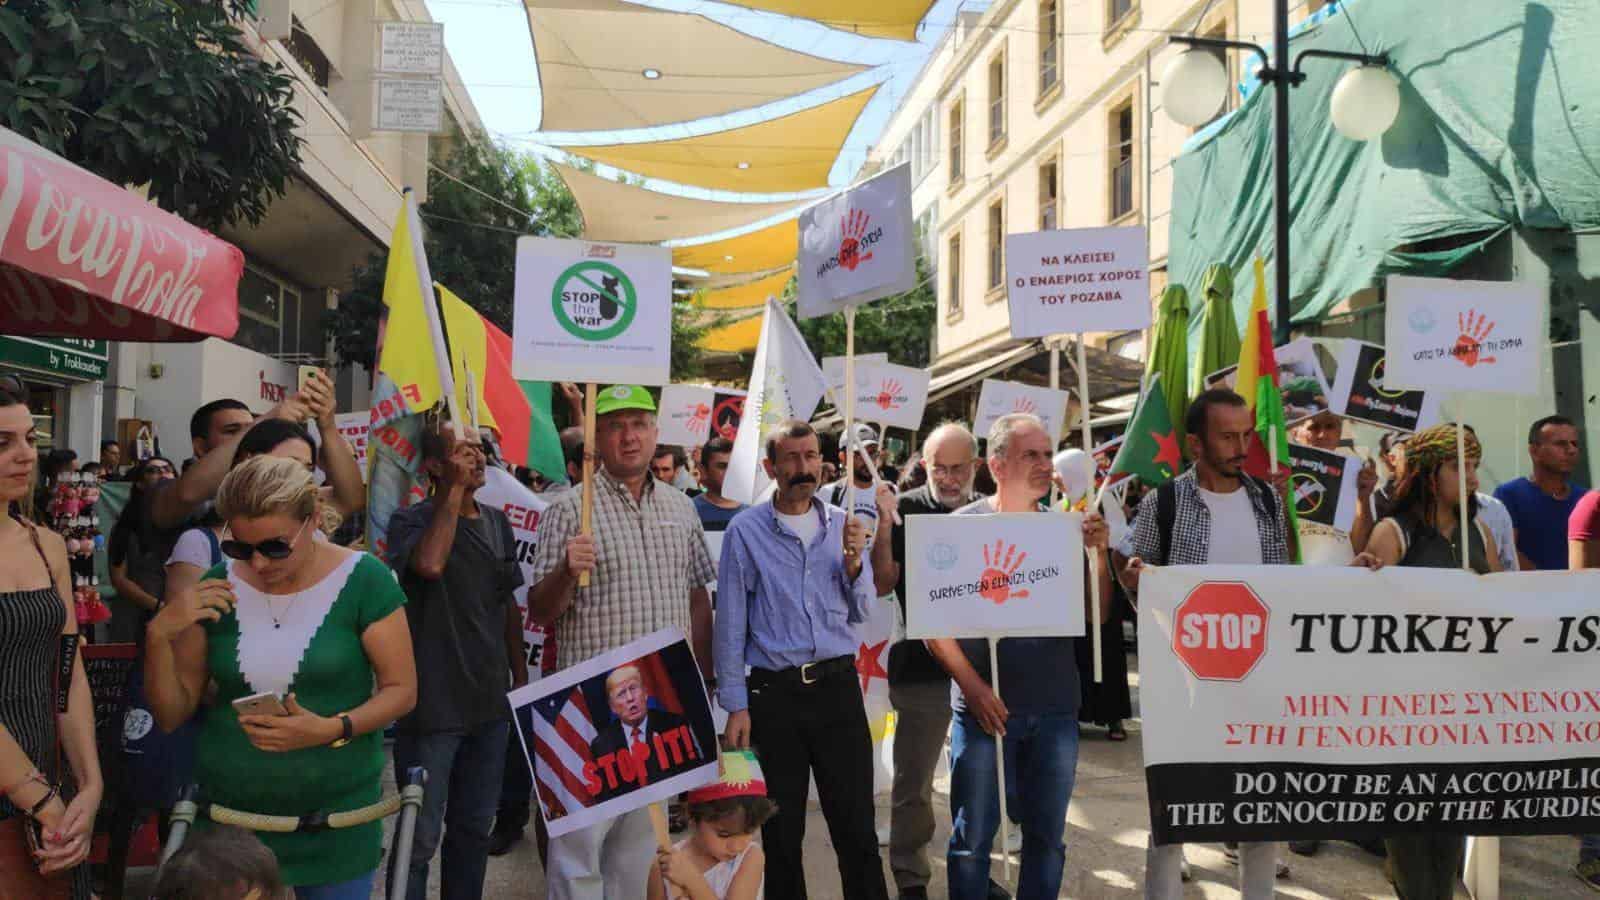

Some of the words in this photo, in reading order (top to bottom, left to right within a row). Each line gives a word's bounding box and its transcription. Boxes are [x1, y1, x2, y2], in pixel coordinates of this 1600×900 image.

[1041, 255, 1060, 266] ΝΑ
[1064, 251, 1115, 265] ΚΛΕΙΣΕΙ
[1015, 278, 1025, 288] Ο
[1030, 272, 1093, 287] ΕΝΑΕΡΙΟΣ
[1100, 270, 1141, 282] ΧΟΡΟΣ
[562, 290, 599, 304] STOP
[1040, 294, 1066, 305] ΤΟΥ
[1070, 291, 1122, 304] ΡΟΖΑΒΑ
[573, 303, 595, 316] the
[574, 316, 603, 327] war
[49, 349, 60, 368] by
[1181, 613, 1262, 649] STOP
[1291, 613, 1514, 653] TURKEY
[1552, 615, 1600, 653] IS
[1281, 695, 1350, 717] ΜΗΝ
[1361, 694, 1456, 717] ΓΙΝΕΙΣ
[1225, 723, 1286, 745] ΣΤΗ
[1297, 723, 1489, 747] ΓΕΝΟΚΤΟΝΙΑ
[1497, 721, 1555, 744] ΤΩΝ
[582, 740, 650, 797] STOP
[653, 724, 697, 771] IT!
[1233, 772, 1277, 794] DO
[1283, 772, 1348, 794] NOT
[1352, 774, 1391, 794] BE
[1397, 773, 1437, 795] AN
[1167, 802, 1225, 826] THE
[1233, 801, 1387, 824] GENOCIDE
[1393, 801, 1434, 822] OF
[1439, 800, 1495, 820] THE
